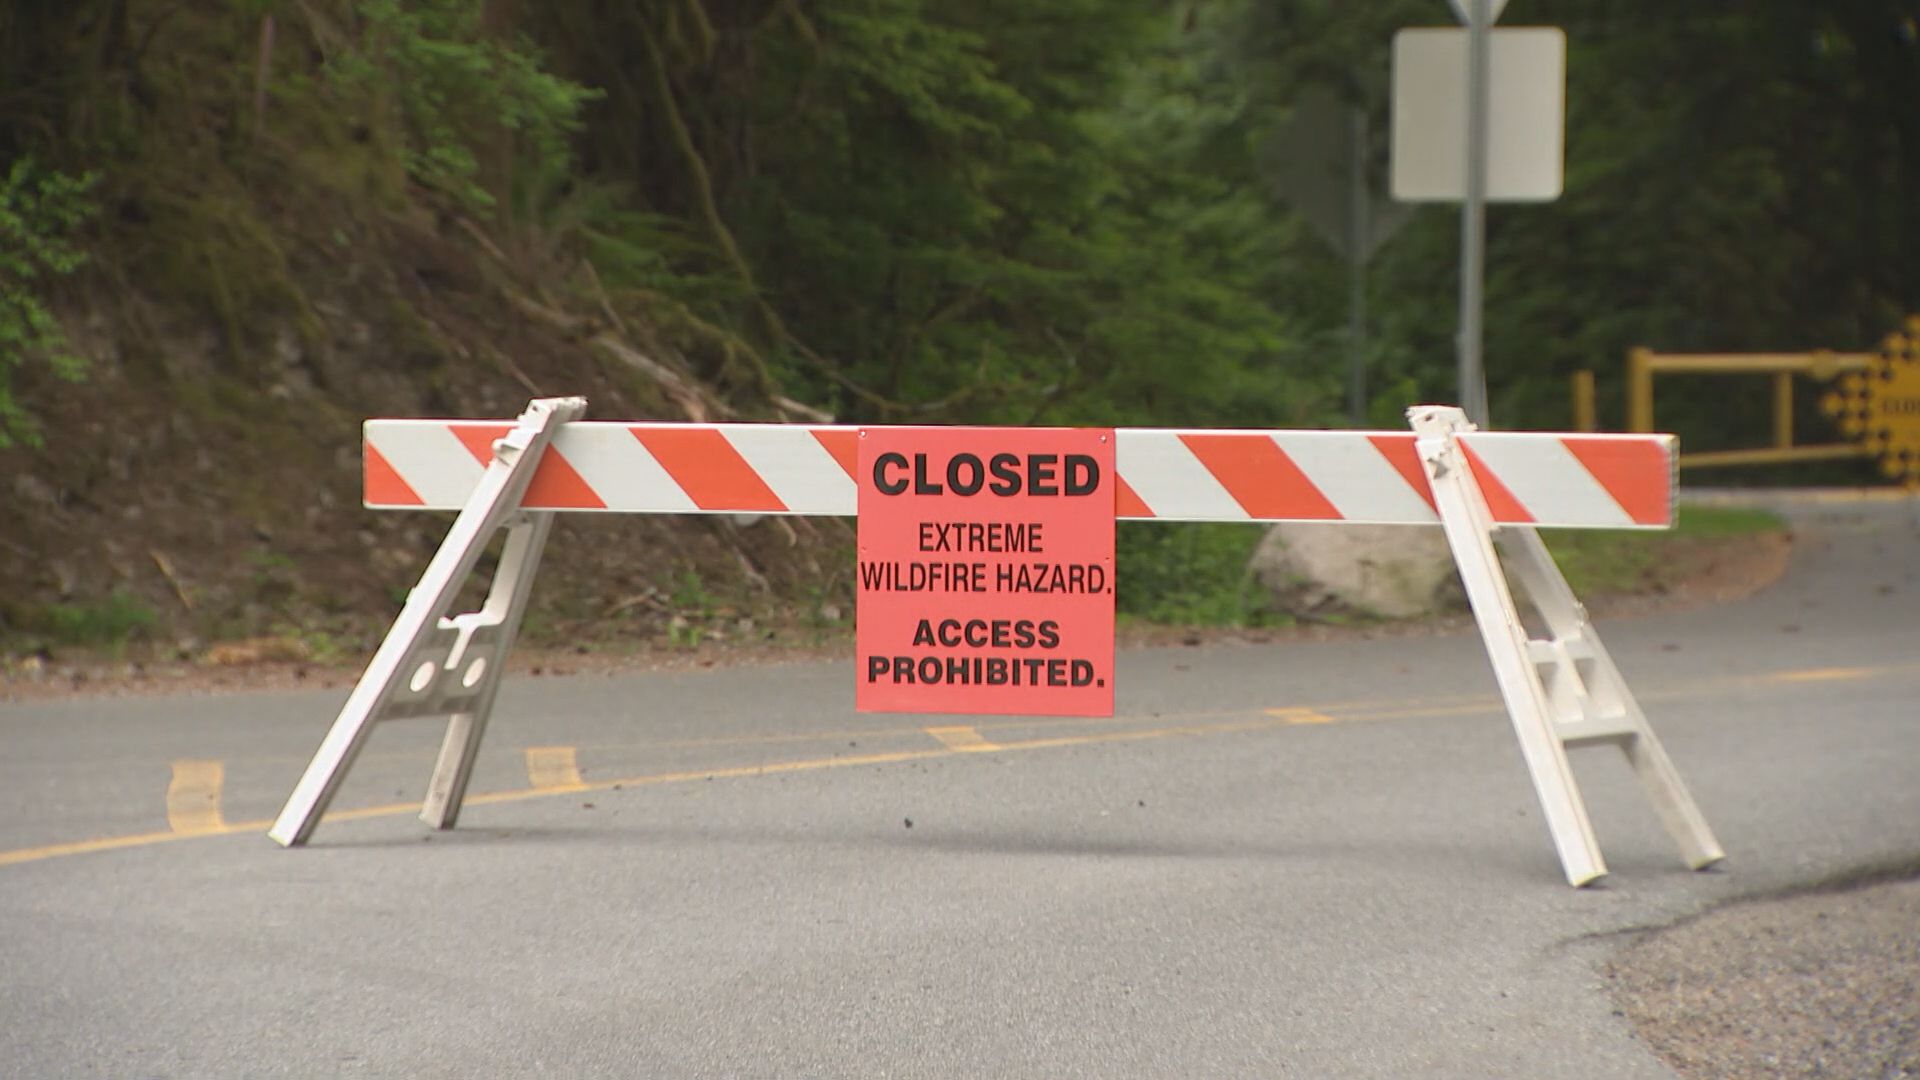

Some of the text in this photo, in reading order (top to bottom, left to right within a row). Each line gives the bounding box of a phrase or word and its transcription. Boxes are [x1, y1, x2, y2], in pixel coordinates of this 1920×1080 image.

[873, 452, 1099, 496] CLOSED
[920, 523, 1042, 552] EXTREME
[861, 562, 1111, 593] WILDFIRE HAZARD.
[913, 619, 1059, 648] ACCESS
[869, 656, 1104, 687] PROHIBITED.
